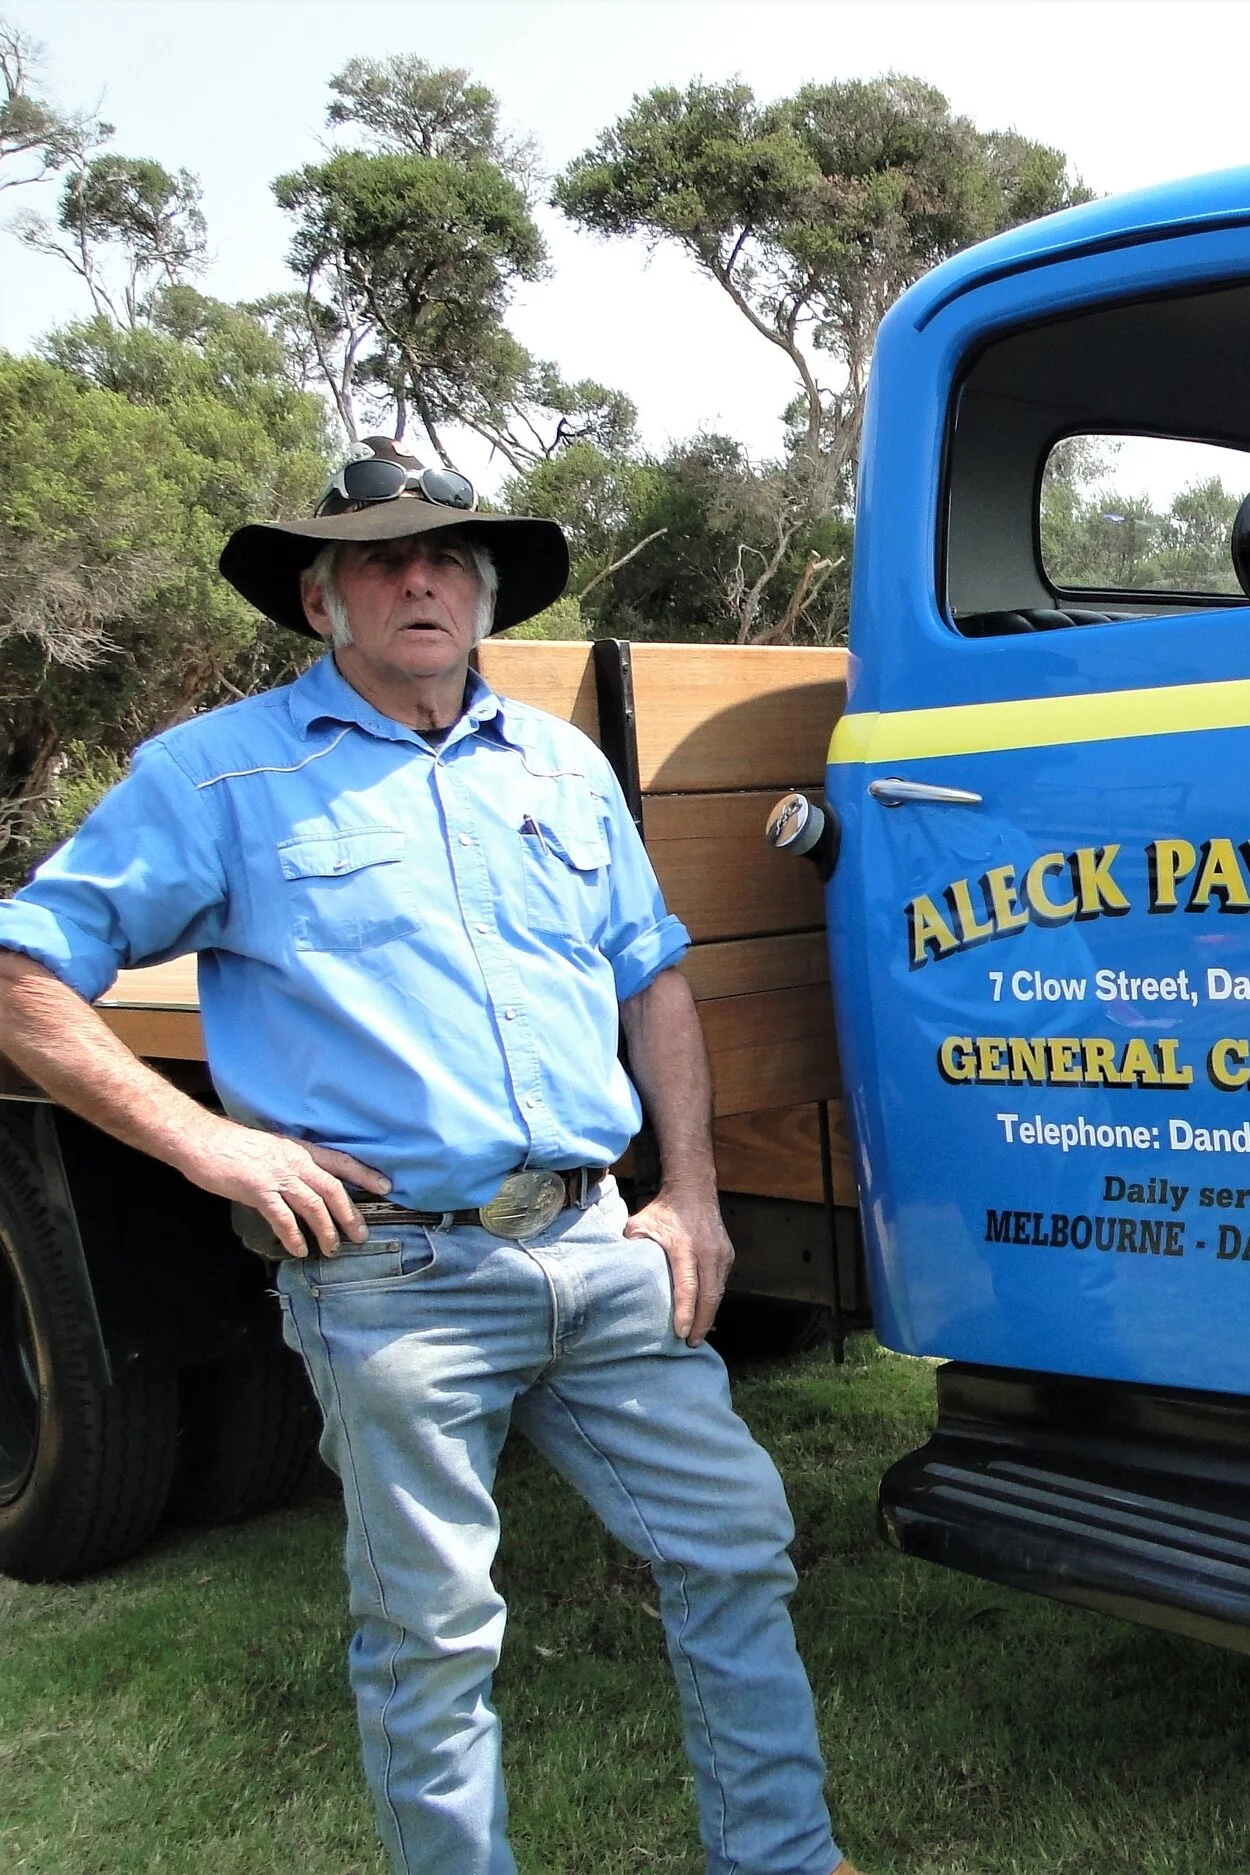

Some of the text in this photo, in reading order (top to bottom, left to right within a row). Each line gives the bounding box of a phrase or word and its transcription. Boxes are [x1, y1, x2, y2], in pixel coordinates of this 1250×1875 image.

[904, 842, 1131, 972] ALECK
[989, 971, 1003, 1001] 7
[1012, 970, 1086, 1001] Clow
[1095, 969, 1198, 1007] Street,
[937, 1036, 1193, 1090] GENERAL
[997, 1113, 1160, 1152] Telephone:
[1103, 1176, 1189, 1212] Daily
[984, 1209, 1185, 1257] MELBOURNE
